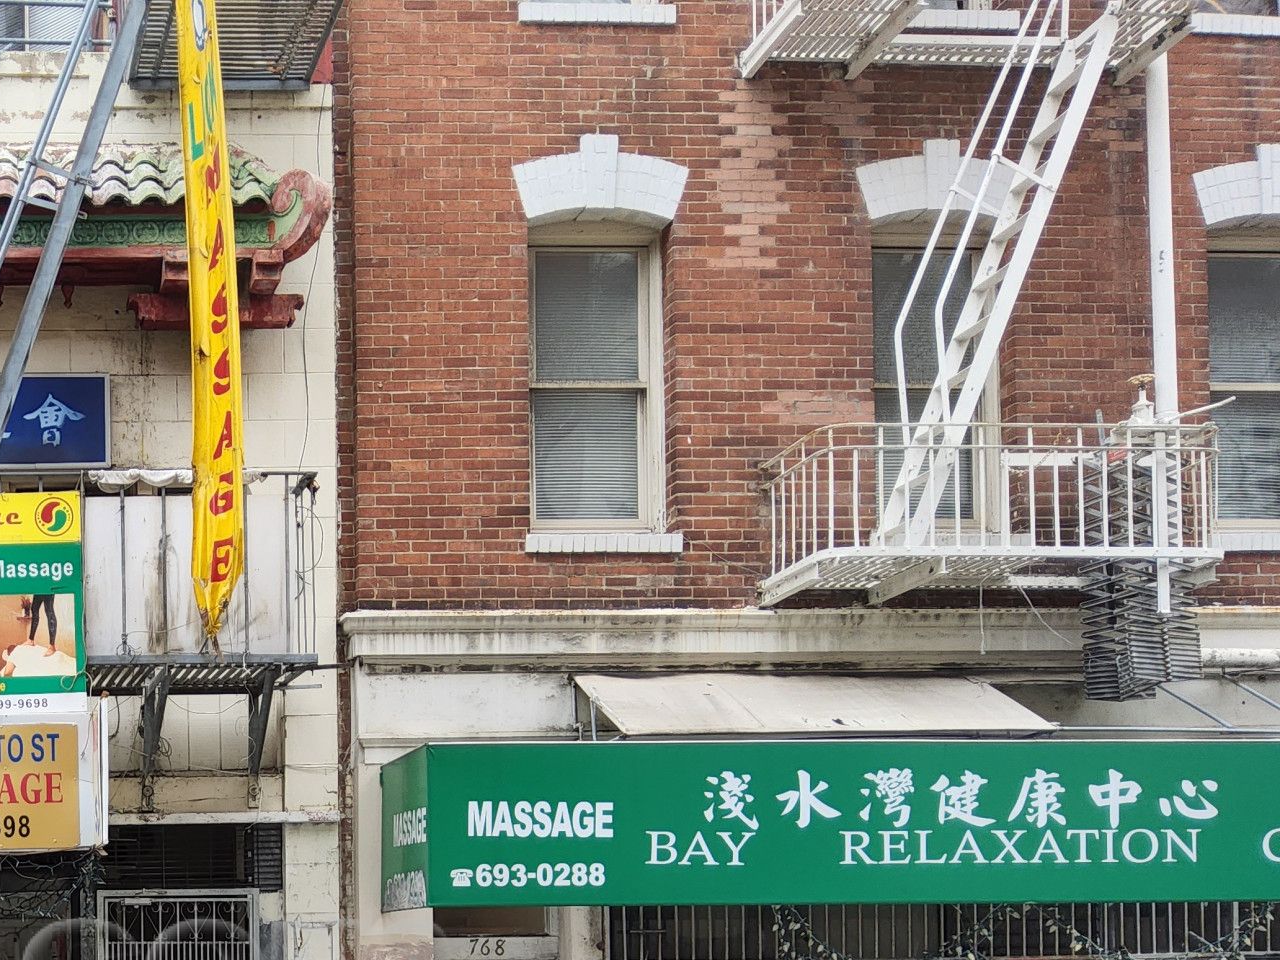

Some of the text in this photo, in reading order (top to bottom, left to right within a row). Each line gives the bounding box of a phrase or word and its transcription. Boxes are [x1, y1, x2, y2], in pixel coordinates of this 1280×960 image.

[31, 733, 60, 761] ST
[703, 767, 1220, 831] 淺水灣健康中心
[393, 807, 427, 847] MASSAGE
[468, 801, 615, 839] MASSAGE
[645, 830, 756, 866] BAY
[840, 828, 1203, 865] RELAXATION
[475, 863, 606, 888] 693-0288
[470, 938, 506, 956] 768
